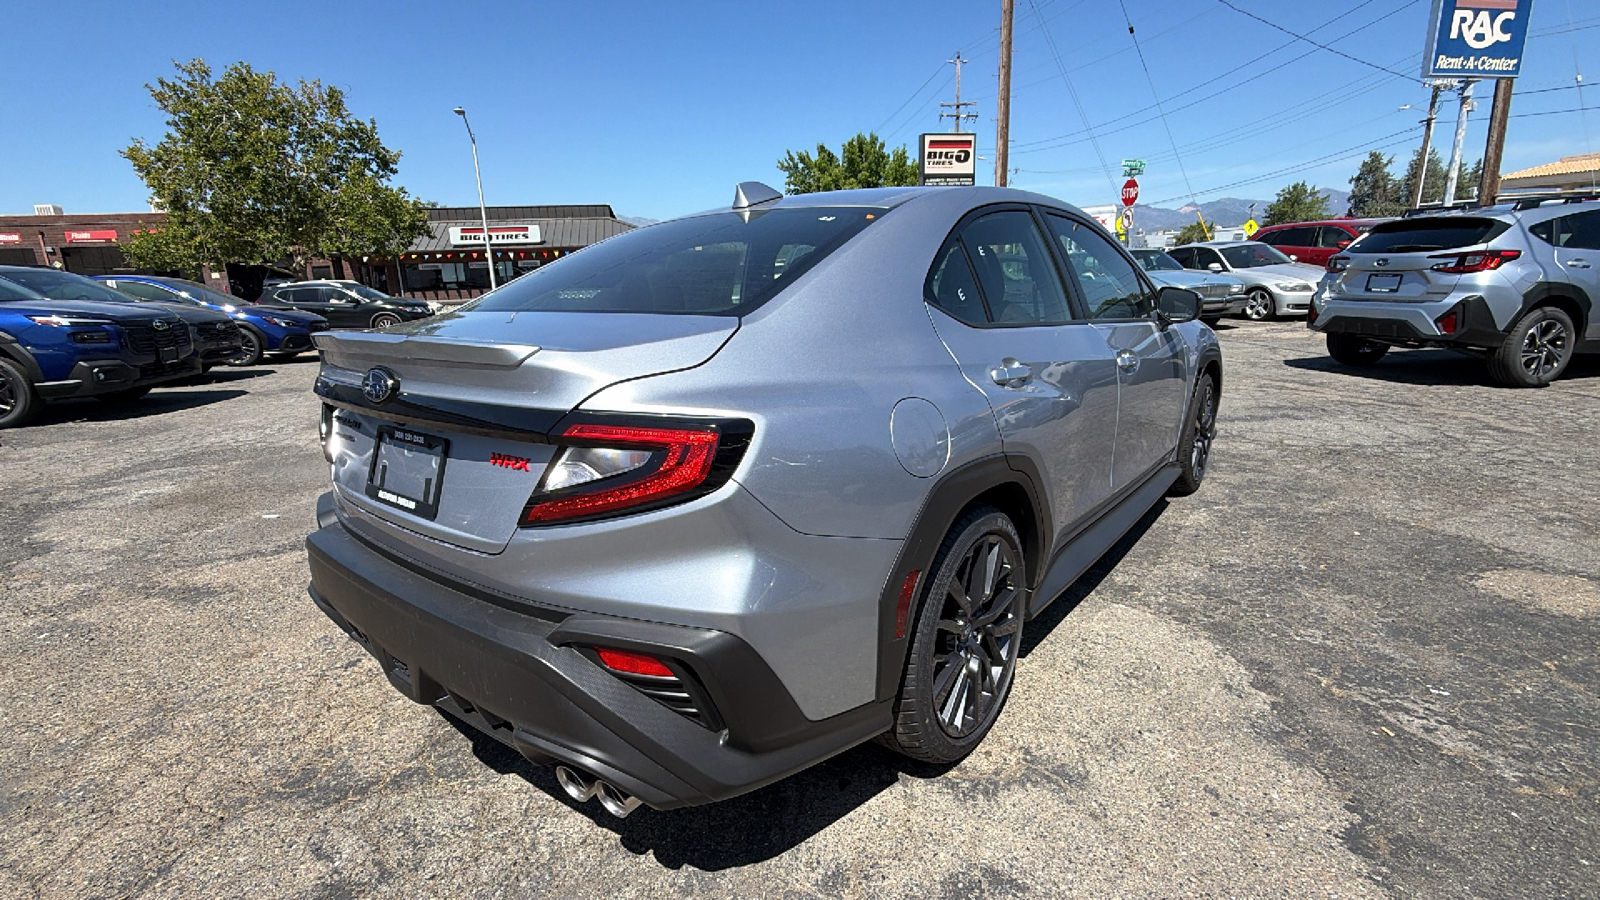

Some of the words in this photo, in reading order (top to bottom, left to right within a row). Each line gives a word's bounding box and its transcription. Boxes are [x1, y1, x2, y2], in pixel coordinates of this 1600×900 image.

[1450, 9, 1516, 49] RAC
[926, 151, 955, 160] BIG
[955, 149, 971, 164] O
[1122, 187, 1138, 199] STOP
[490, 452, 531, 472] WRX
